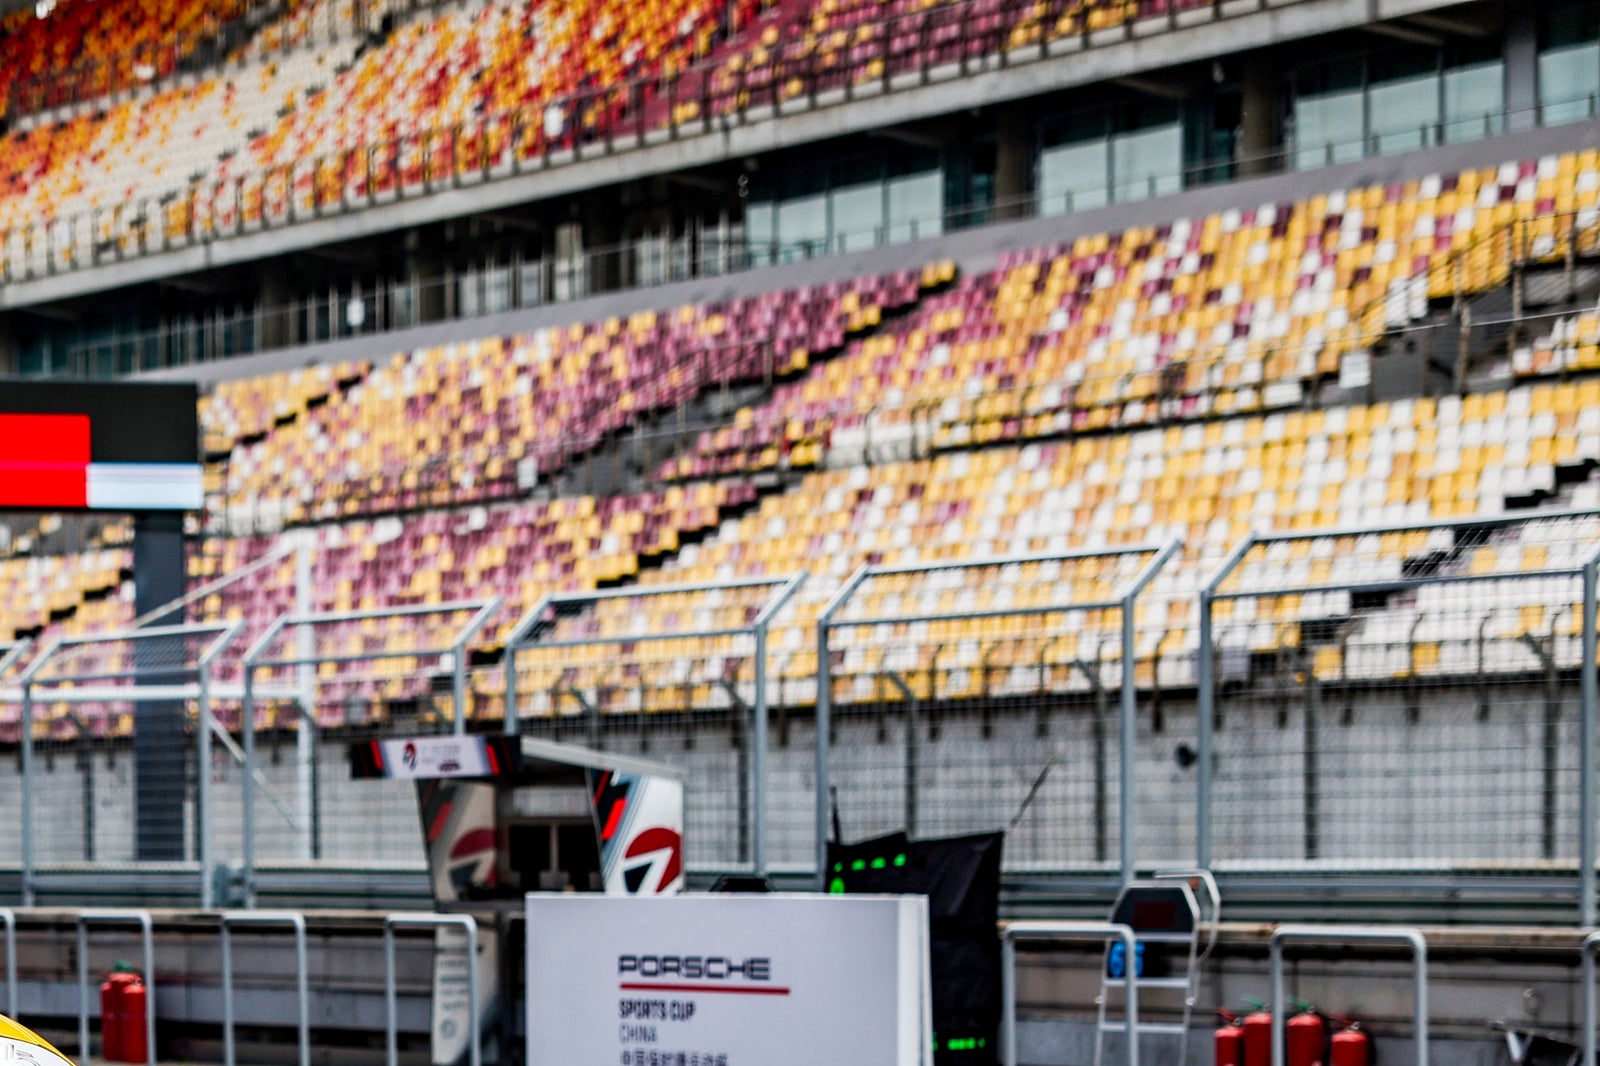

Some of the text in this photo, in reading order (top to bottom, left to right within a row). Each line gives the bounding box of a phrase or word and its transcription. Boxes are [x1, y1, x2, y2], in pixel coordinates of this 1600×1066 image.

[618, 955, 771, 981] PORSCHE
[618, 998, 696, 1021] SPORTS CUP
[618, 1023, 658, 1044] CHINA
